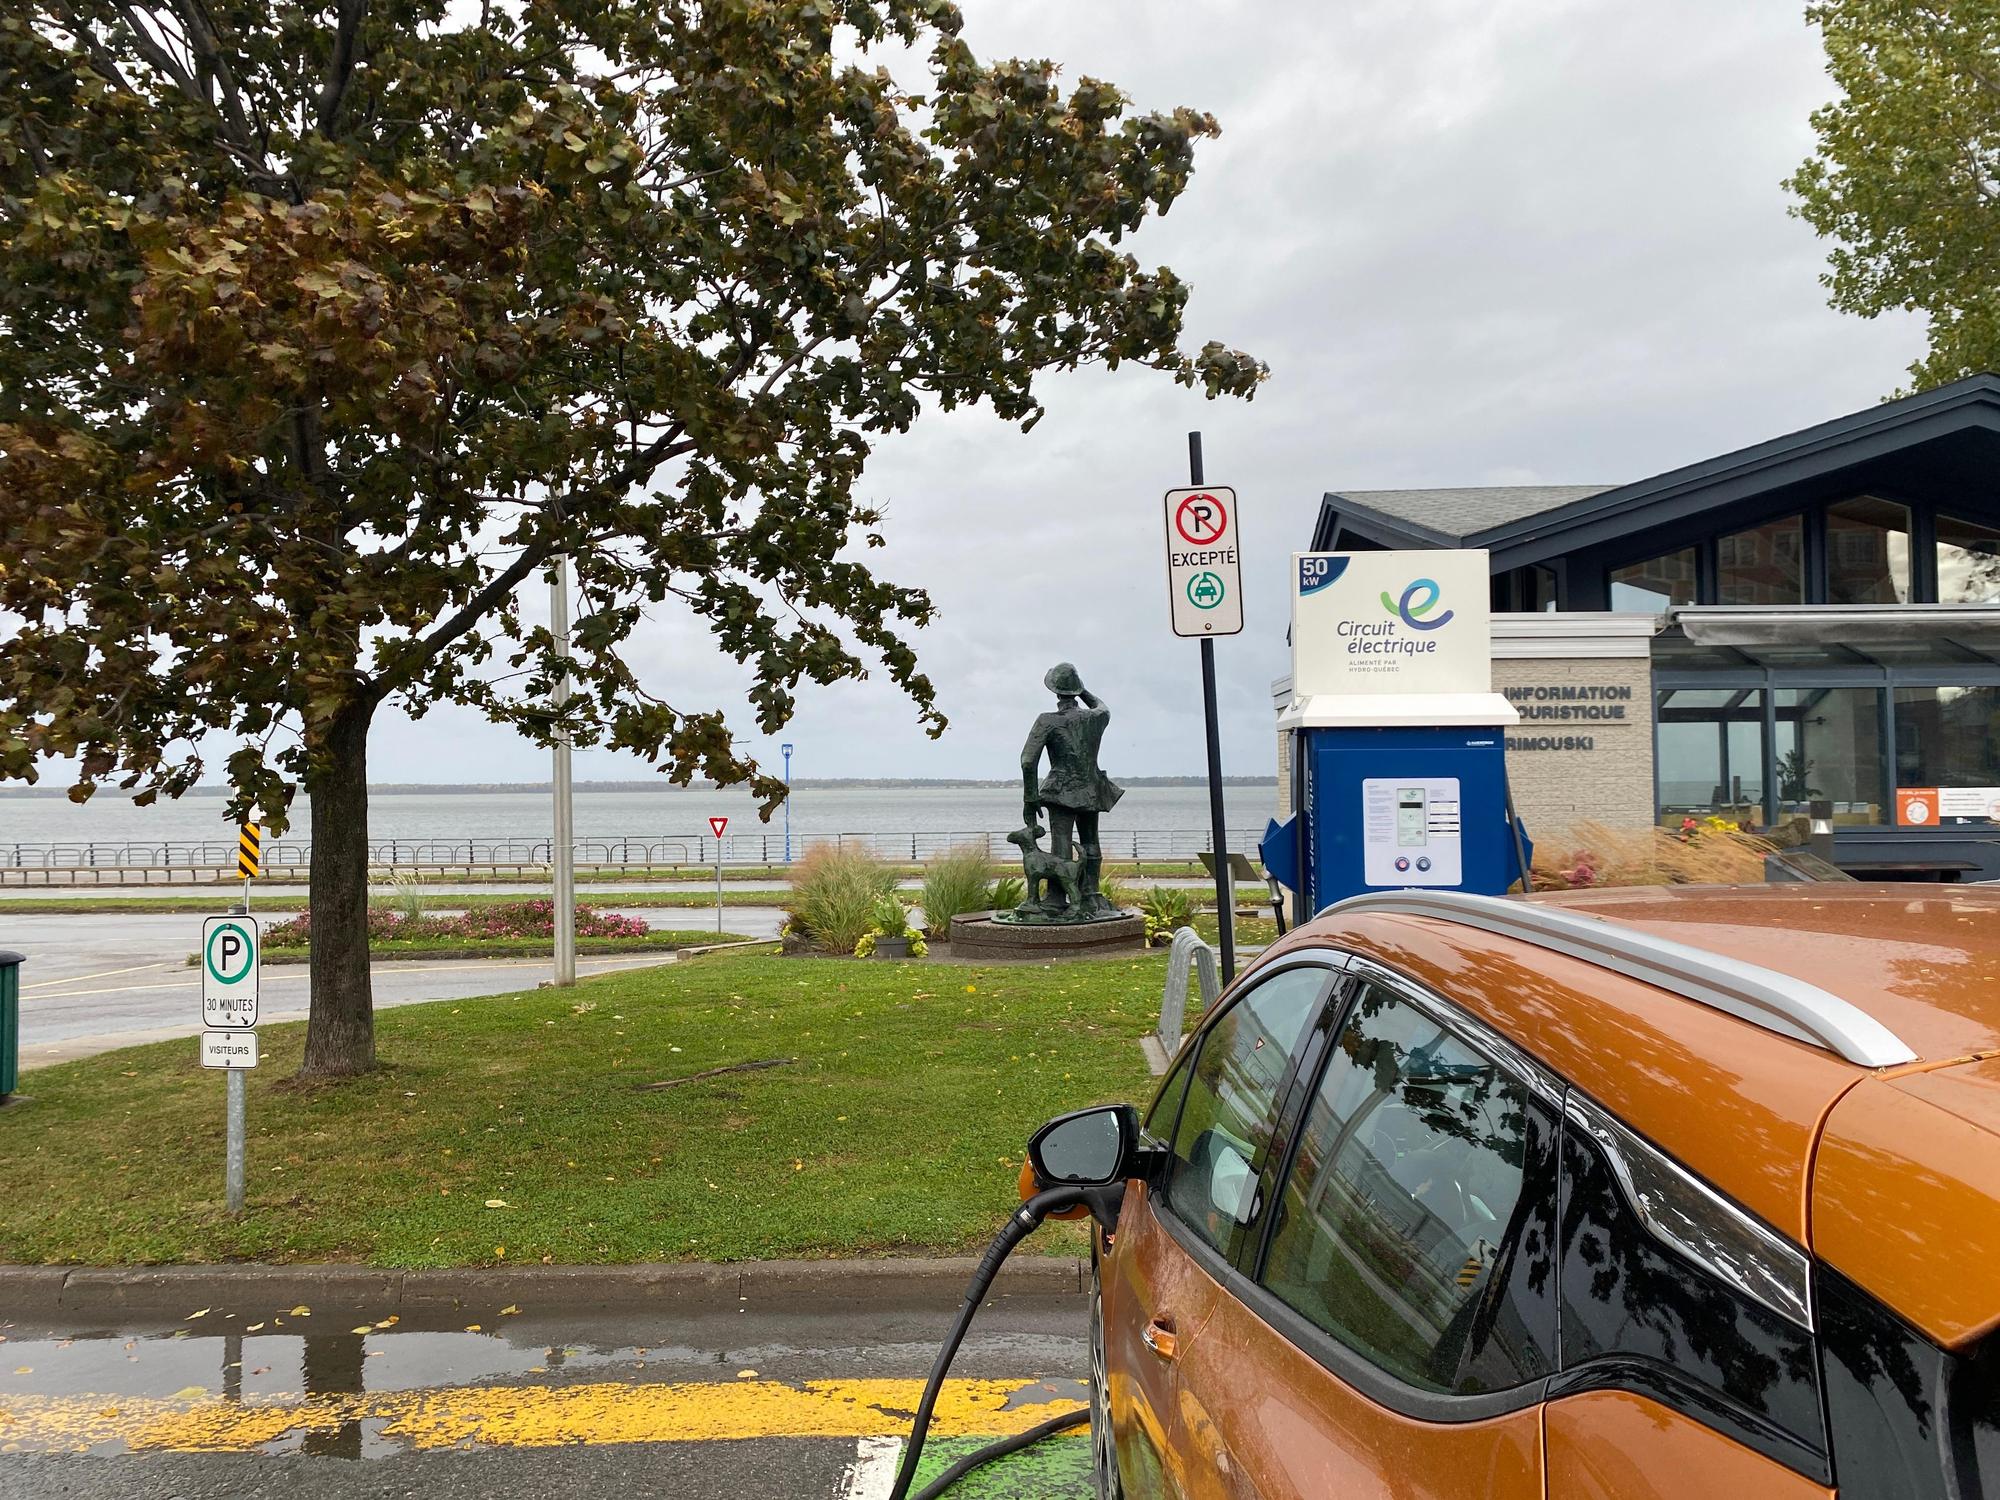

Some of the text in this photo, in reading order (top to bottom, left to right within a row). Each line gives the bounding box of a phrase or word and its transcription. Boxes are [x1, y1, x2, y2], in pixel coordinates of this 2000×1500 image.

[1172, 546, 1236, 567] EXCEPTÉ
[1302, 559, 1328, 576] 50
[1303, 577, 1319, 586] kW
[1337, 620, 1395, 636] Circuit
[1347, 638, 1437, 657] électrique
[1504, 686, 1631, 700] INFORMATION
[1513, 705, 1625, 719] OURISTIQUE
[1504, 737, 1593, 751] RIMOUSKI
[222, 935, 240, 971] P
[207, 998, 253, 1012] 30 MINUTES
[209, 1045, 249, 1055] VISITEURS
